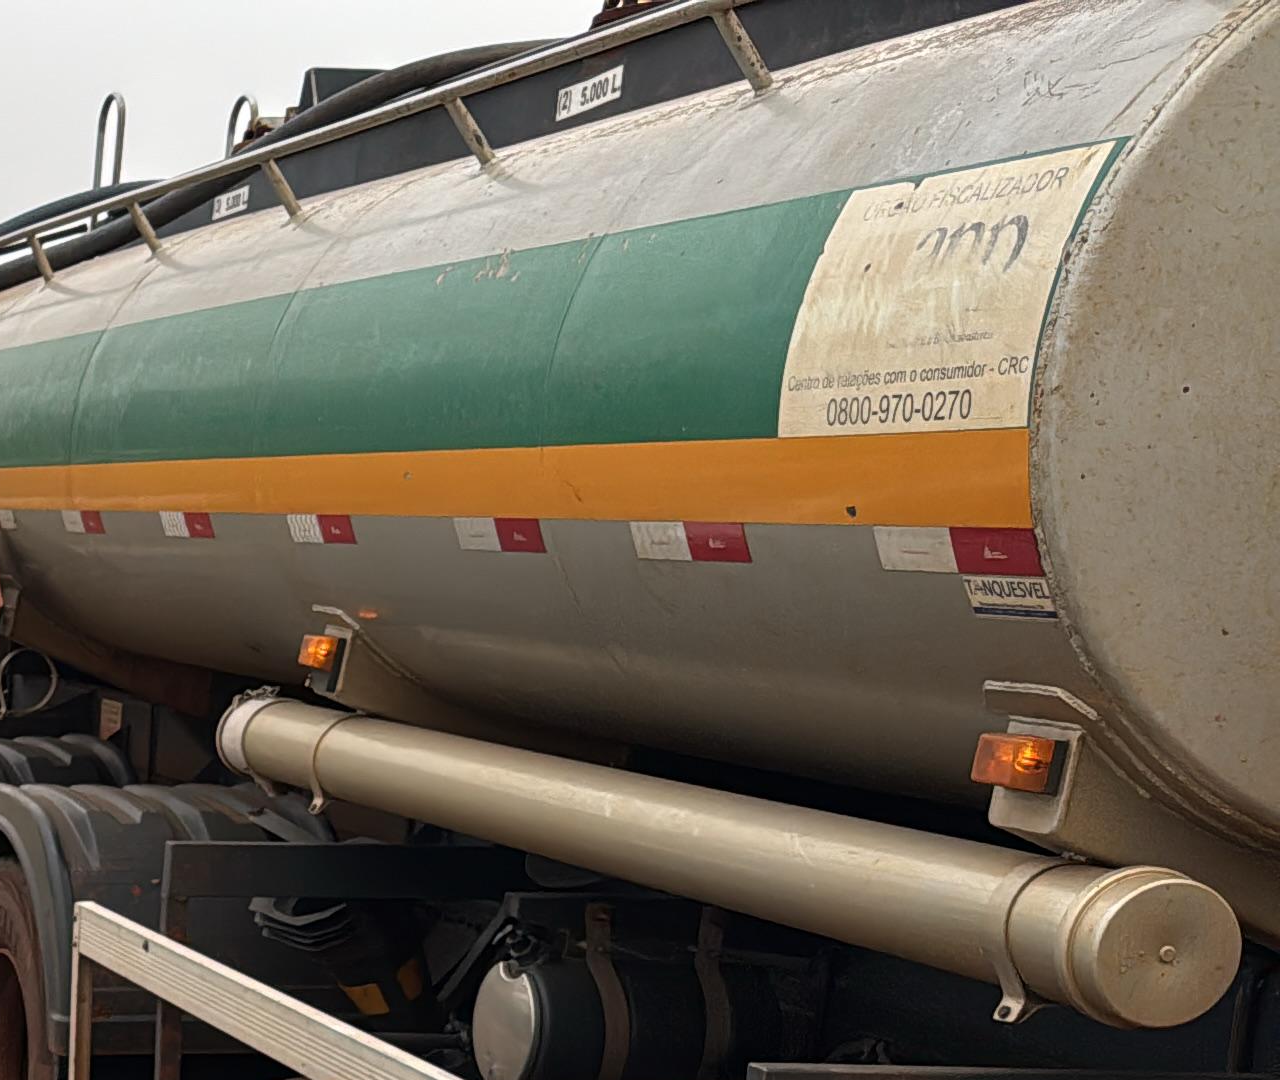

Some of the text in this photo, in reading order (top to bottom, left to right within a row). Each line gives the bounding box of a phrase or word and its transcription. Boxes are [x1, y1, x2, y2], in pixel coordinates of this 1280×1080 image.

[580, 77, 609, 106] 5.000
[822, 375, 835, 389] de
[883, 370, 907, 385] com
[909, 369, 917, 383] o
[920, 361, 987, 382] consumidor
[998, 356, 1029, 376] CRC
[826, 389, 973, 427] 0800-970-0270
